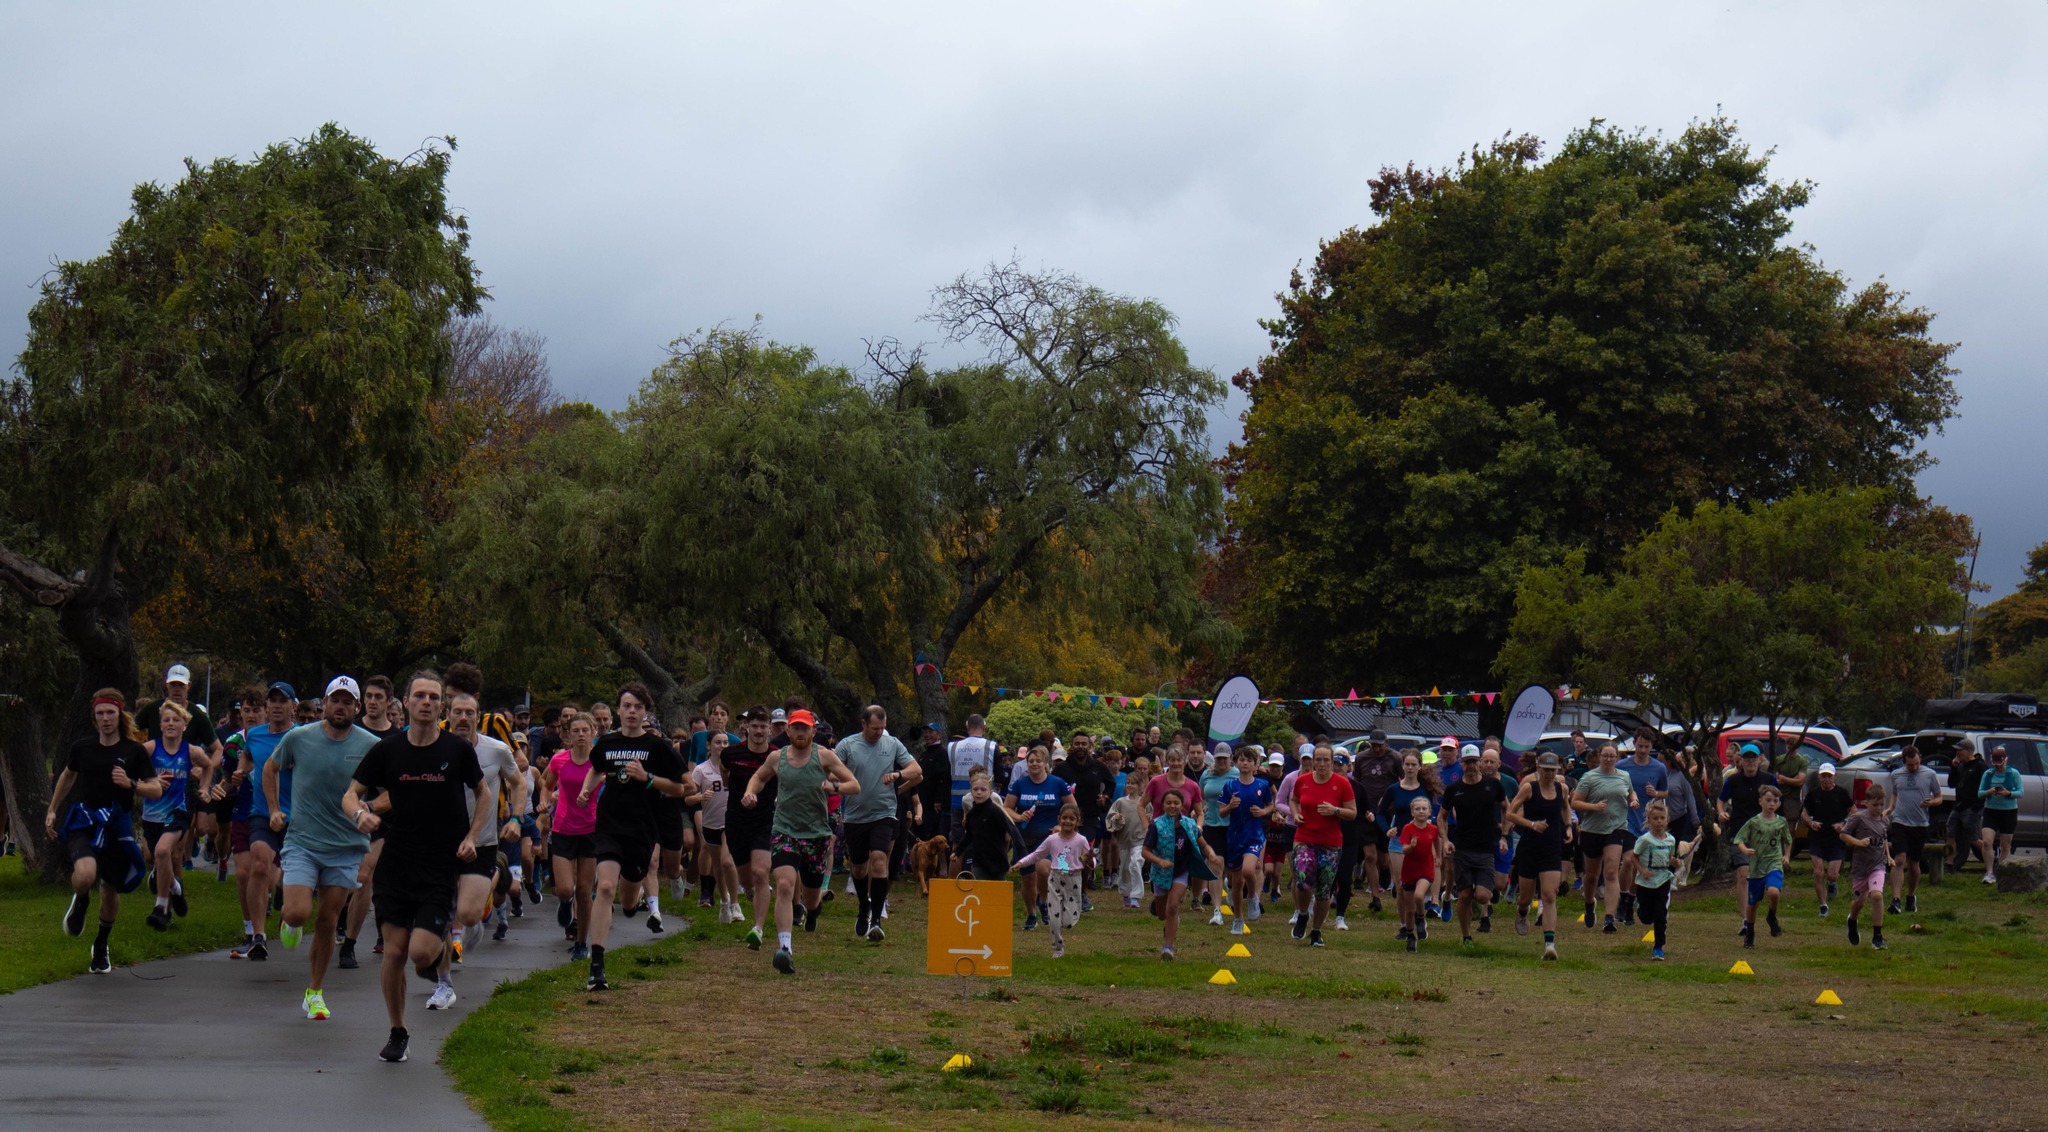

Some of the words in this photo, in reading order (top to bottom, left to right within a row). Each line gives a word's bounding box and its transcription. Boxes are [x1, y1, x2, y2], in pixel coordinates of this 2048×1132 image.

[1221, 697, 1251, 711] parkrun
[1516, 706, 1546, 720] parkrun
[958, 745, 981, 753] parkrun
[605, 750, 649, 761] WHANGANUI
